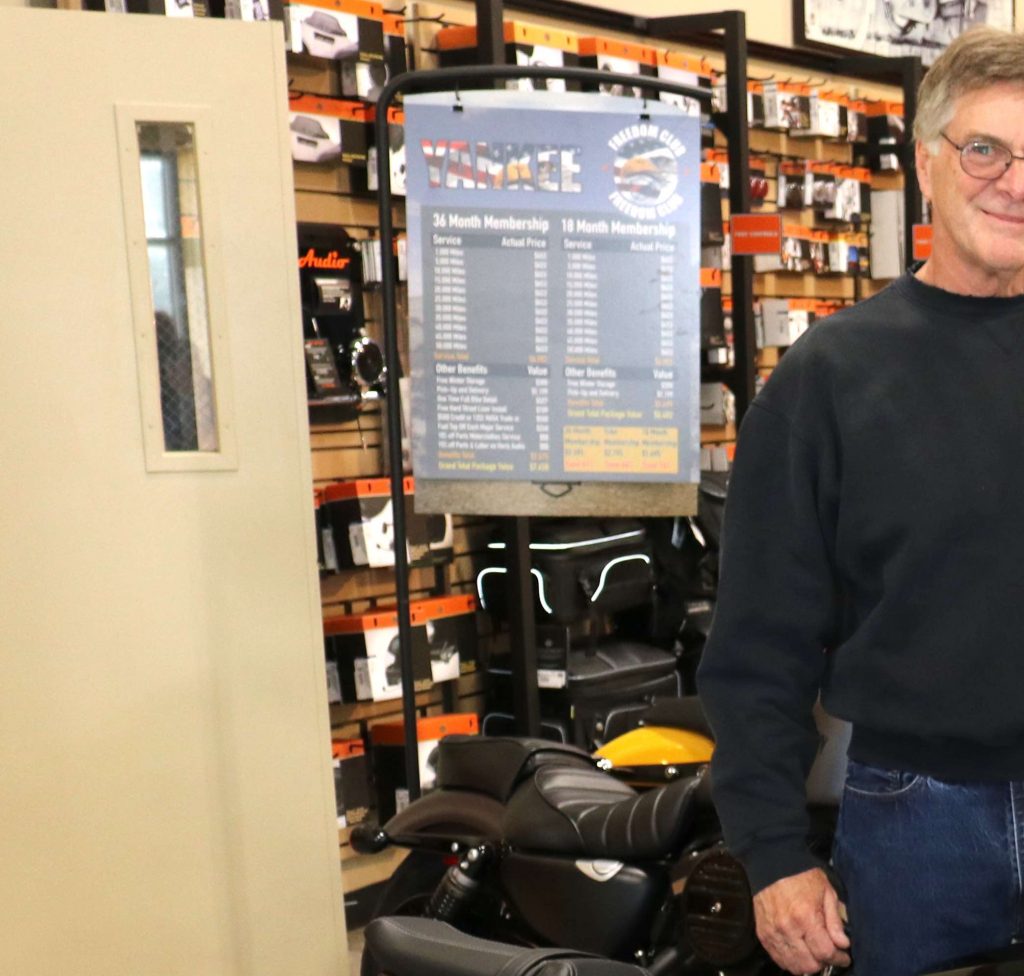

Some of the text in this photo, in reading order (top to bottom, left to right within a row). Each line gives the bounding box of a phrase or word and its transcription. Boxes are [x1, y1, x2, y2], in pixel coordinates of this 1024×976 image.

[607, 123, 687, 157] FREEDOM CLUB
[420, 138, 582, 193] YANKEE
[432, 212, 549, 234] 36 Month Membership
[562, 218, 677, 239] 18 Month Membership
[432, 234, 462, 246] Service
[501, 236, 547, 248] Actual Price
[563, 238, 592, 250] Service
[630, 241, 675, 252] Actual Price
[299, 248, 351, 269] Audio
[436, 363, 488, 375] Other Benefits
[527, 365, 548, 376] Value
[565, 367, 617, 379] Other Benefits
[653, 368, 673, 379] Value
